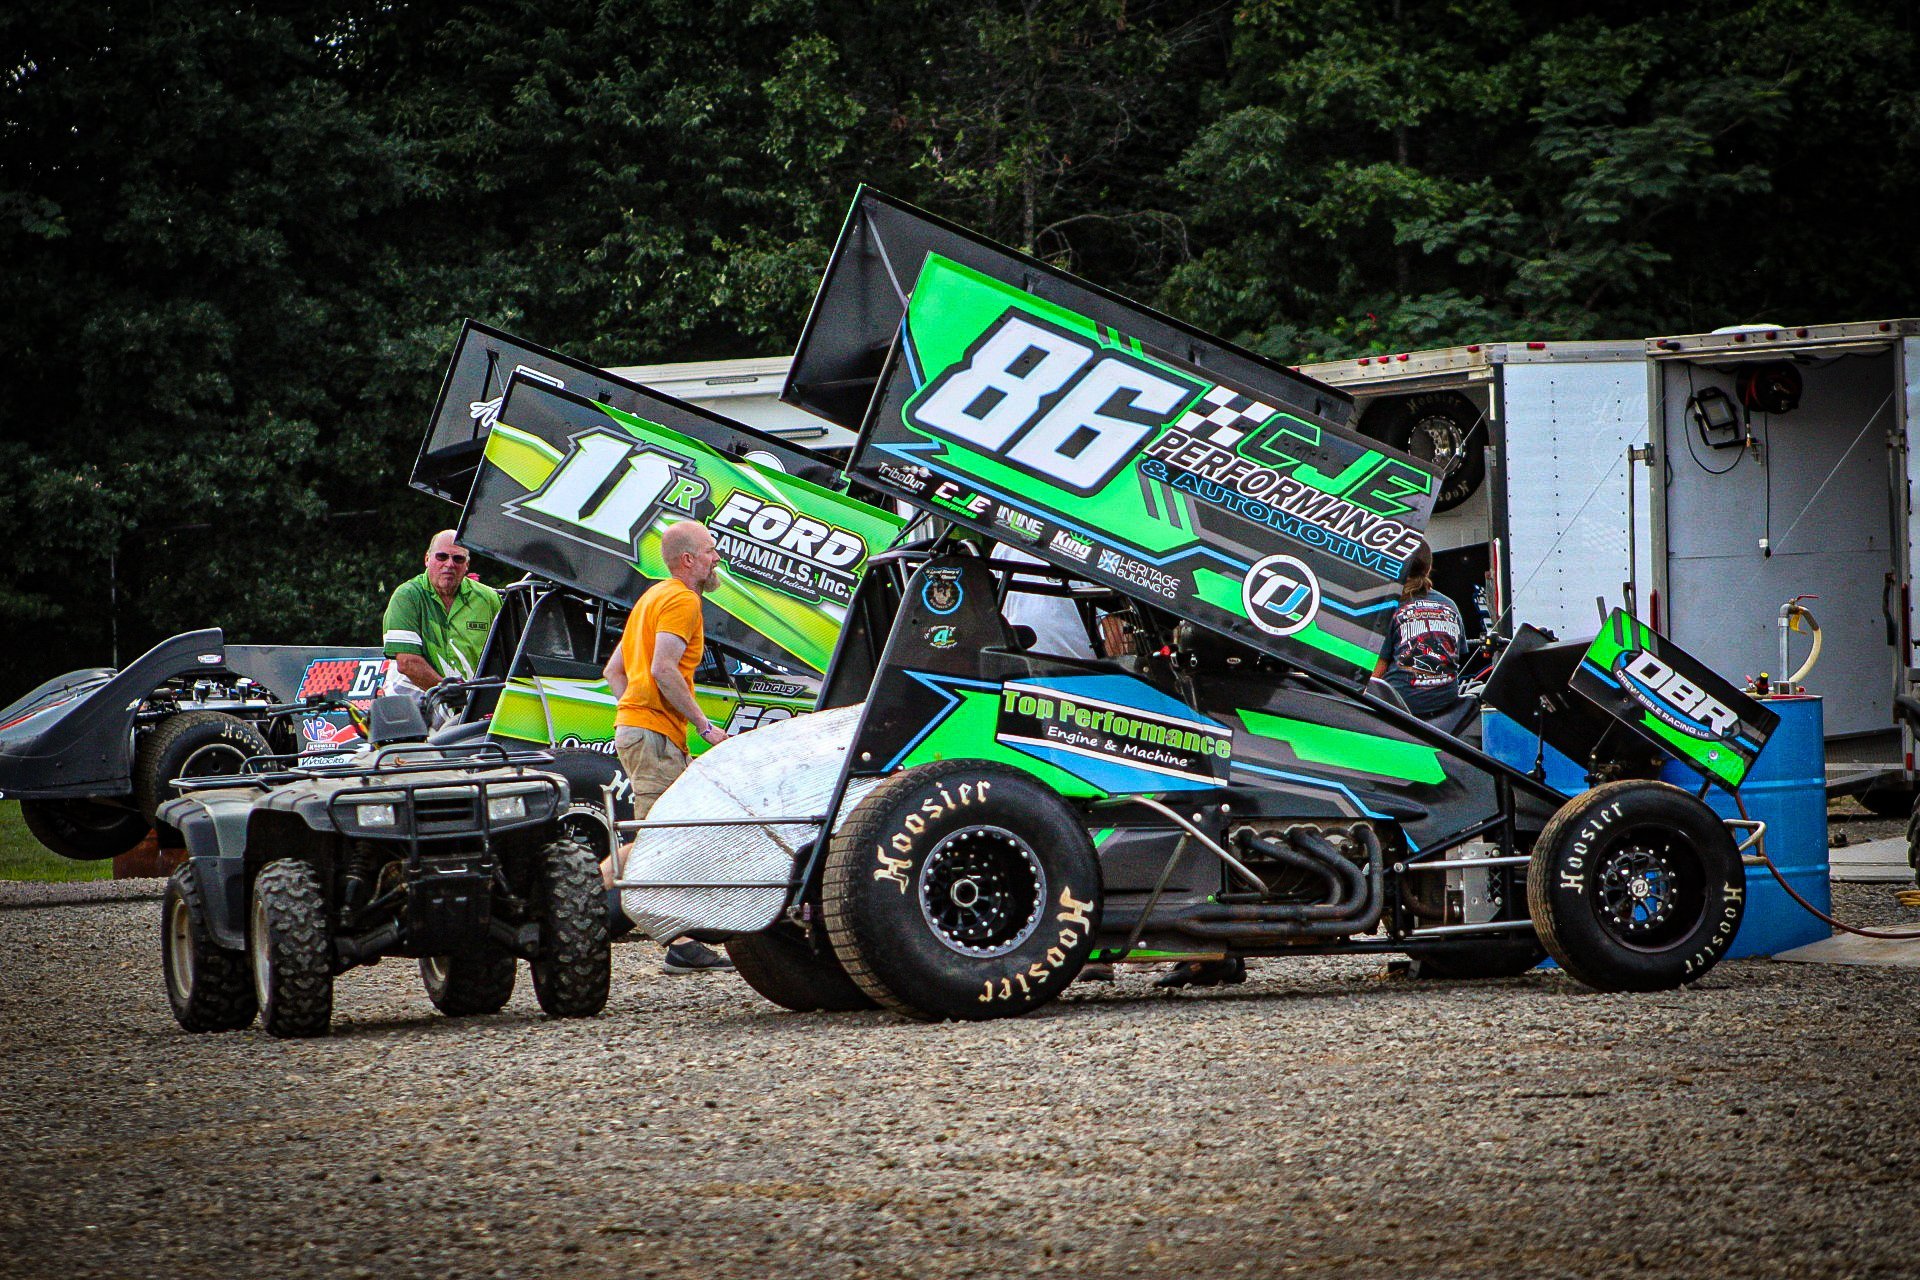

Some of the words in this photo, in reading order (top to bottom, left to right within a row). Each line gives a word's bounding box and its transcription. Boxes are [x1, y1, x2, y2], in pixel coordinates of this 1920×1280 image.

[914, 317, 1190, 489] 86
[520, 433, 684, 545] 11
[878, 461, 928, 492] TriboDyn
[934, 481, 992, 514] CJE
[1143, 428, 1424, 561] PERFORMANCE
[1237, 412, 1432, 517] CJE
[713, 492, 863, 567] FORD
[1052, 529, 1093, 561] King
[1142, 459, 1168, 483] &
[1173, 472, 1404, 580] AUTOMOTIVE
[779, 575, 817, 596] Indiana
[817, 571, 851, 600] Inc.
[1116, 568, 1161, 593] BUILDING
[1119, 556, 1182, 592] HERITAGE
[751, 681, 804, 697] RIDGLEY
[1002, 689, 1054, 720] Top
[1058, 699, 1232, 759] Performance
[1616, 669, 1640, 698] DREW
[1638, 693, 1662, 716] BIBLE
[1661, 711, 1697, 735] RACING
[1624, 648, 1740, 737] DBR
[1047, 725, 1099, 748] Engine
[1104, 739, 1118, 753] &
[1123, 743, 1190, 768] Machine
[874, 780, 992, 895] Hoosier
[1560, 801, 1624, 895] Hoosier
[978, 885, 1095, 1003] Hoosier
[1685, 881, 1743, 974] Hoosier
